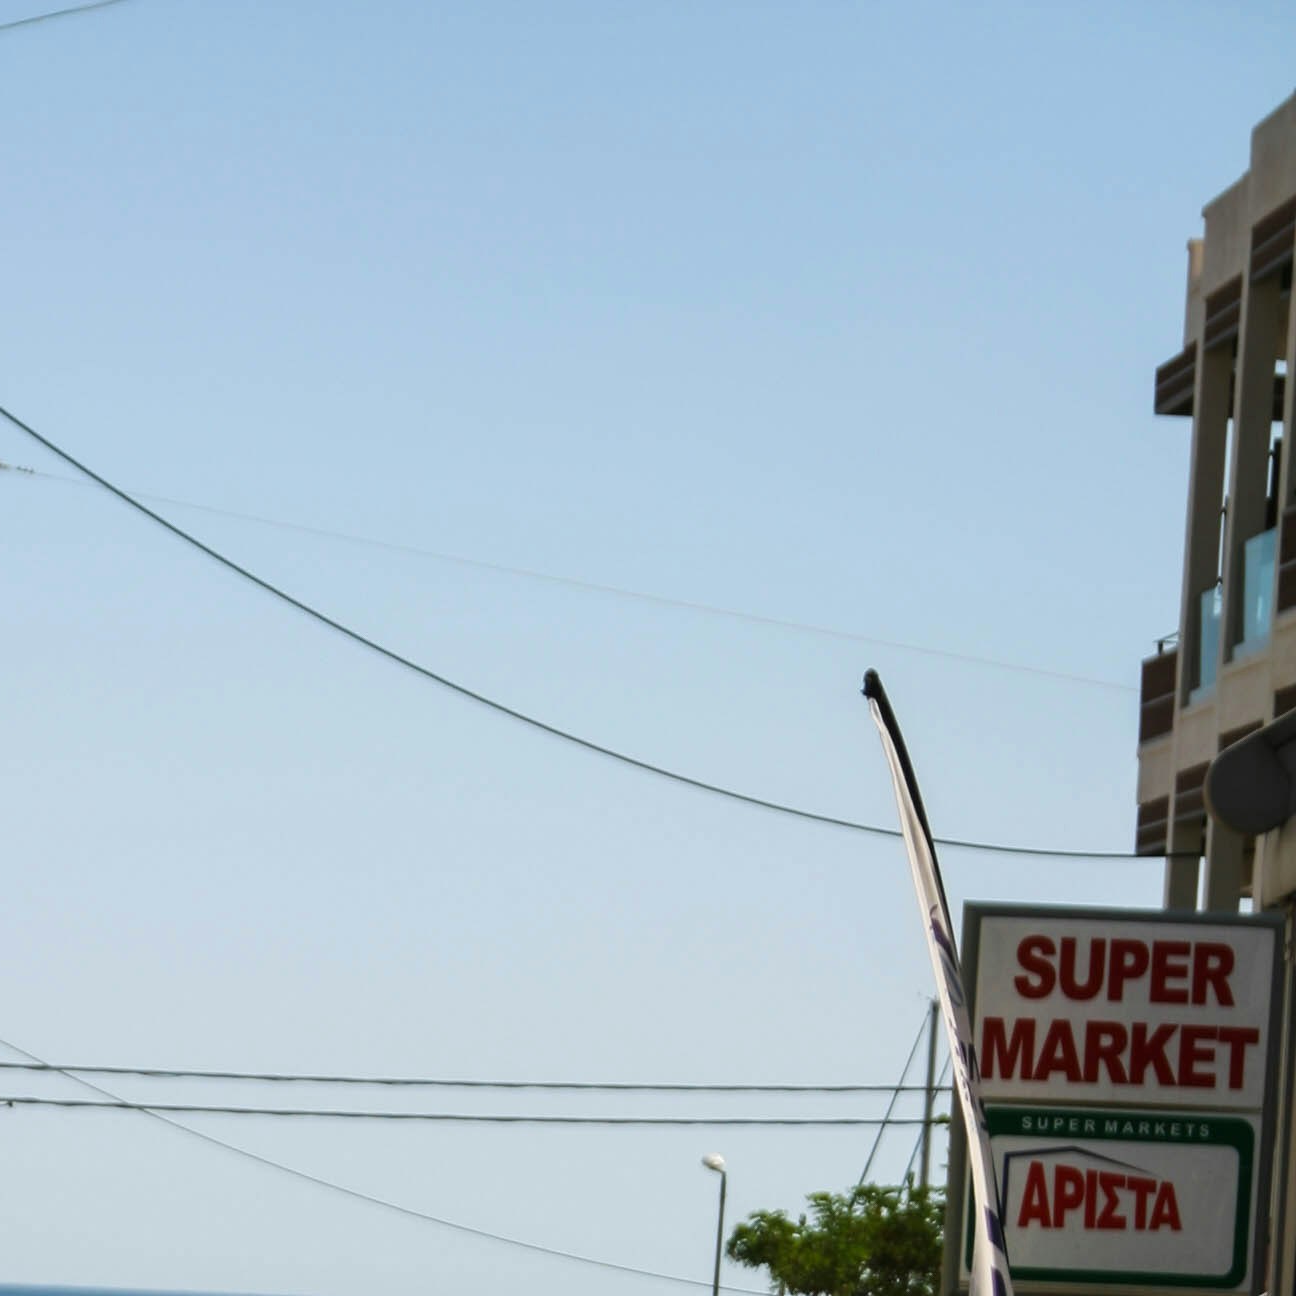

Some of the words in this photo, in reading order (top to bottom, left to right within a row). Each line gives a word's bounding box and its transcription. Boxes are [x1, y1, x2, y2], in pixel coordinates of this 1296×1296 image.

[1014, 934, 1235, 1007] SUPER
[980, 1016, 1260, 1089] MARKET
[1021, 1115, 1096, 1133] SUPER
[1104, 1119, 1212, 1139] MARKETS
[1017, 1160, 1182, 1232] ΑΡΙΣΤΑ
